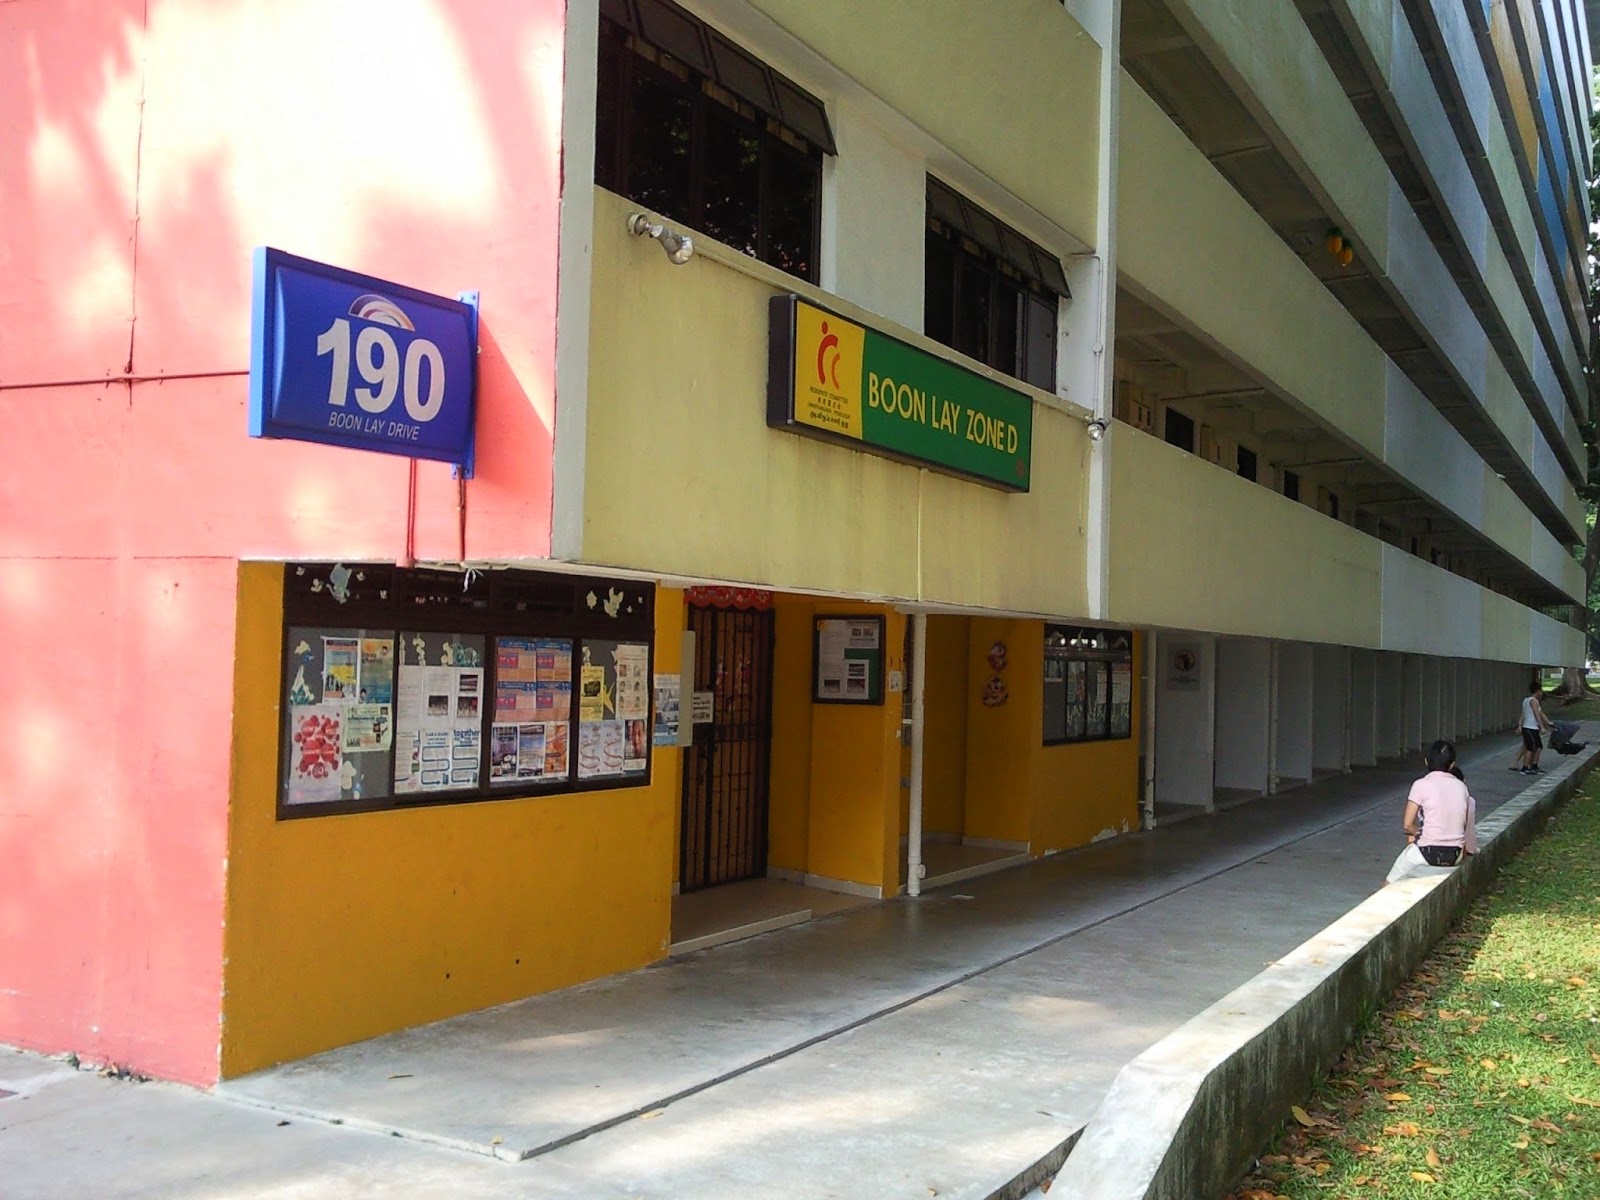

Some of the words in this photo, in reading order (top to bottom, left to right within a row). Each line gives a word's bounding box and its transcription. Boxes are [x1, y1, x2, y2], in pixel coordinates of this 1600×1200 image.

[317, 318, 445, 422] 190
[328, 411, 363, 431] BOON
[364, 417, 386, 434] LAY
[387, 421, 421, 441] DRIVE
[868, 372, 926, 424] BOON
[931, 395, 961, 435] LAY
[453, 728, 480, 739] together
